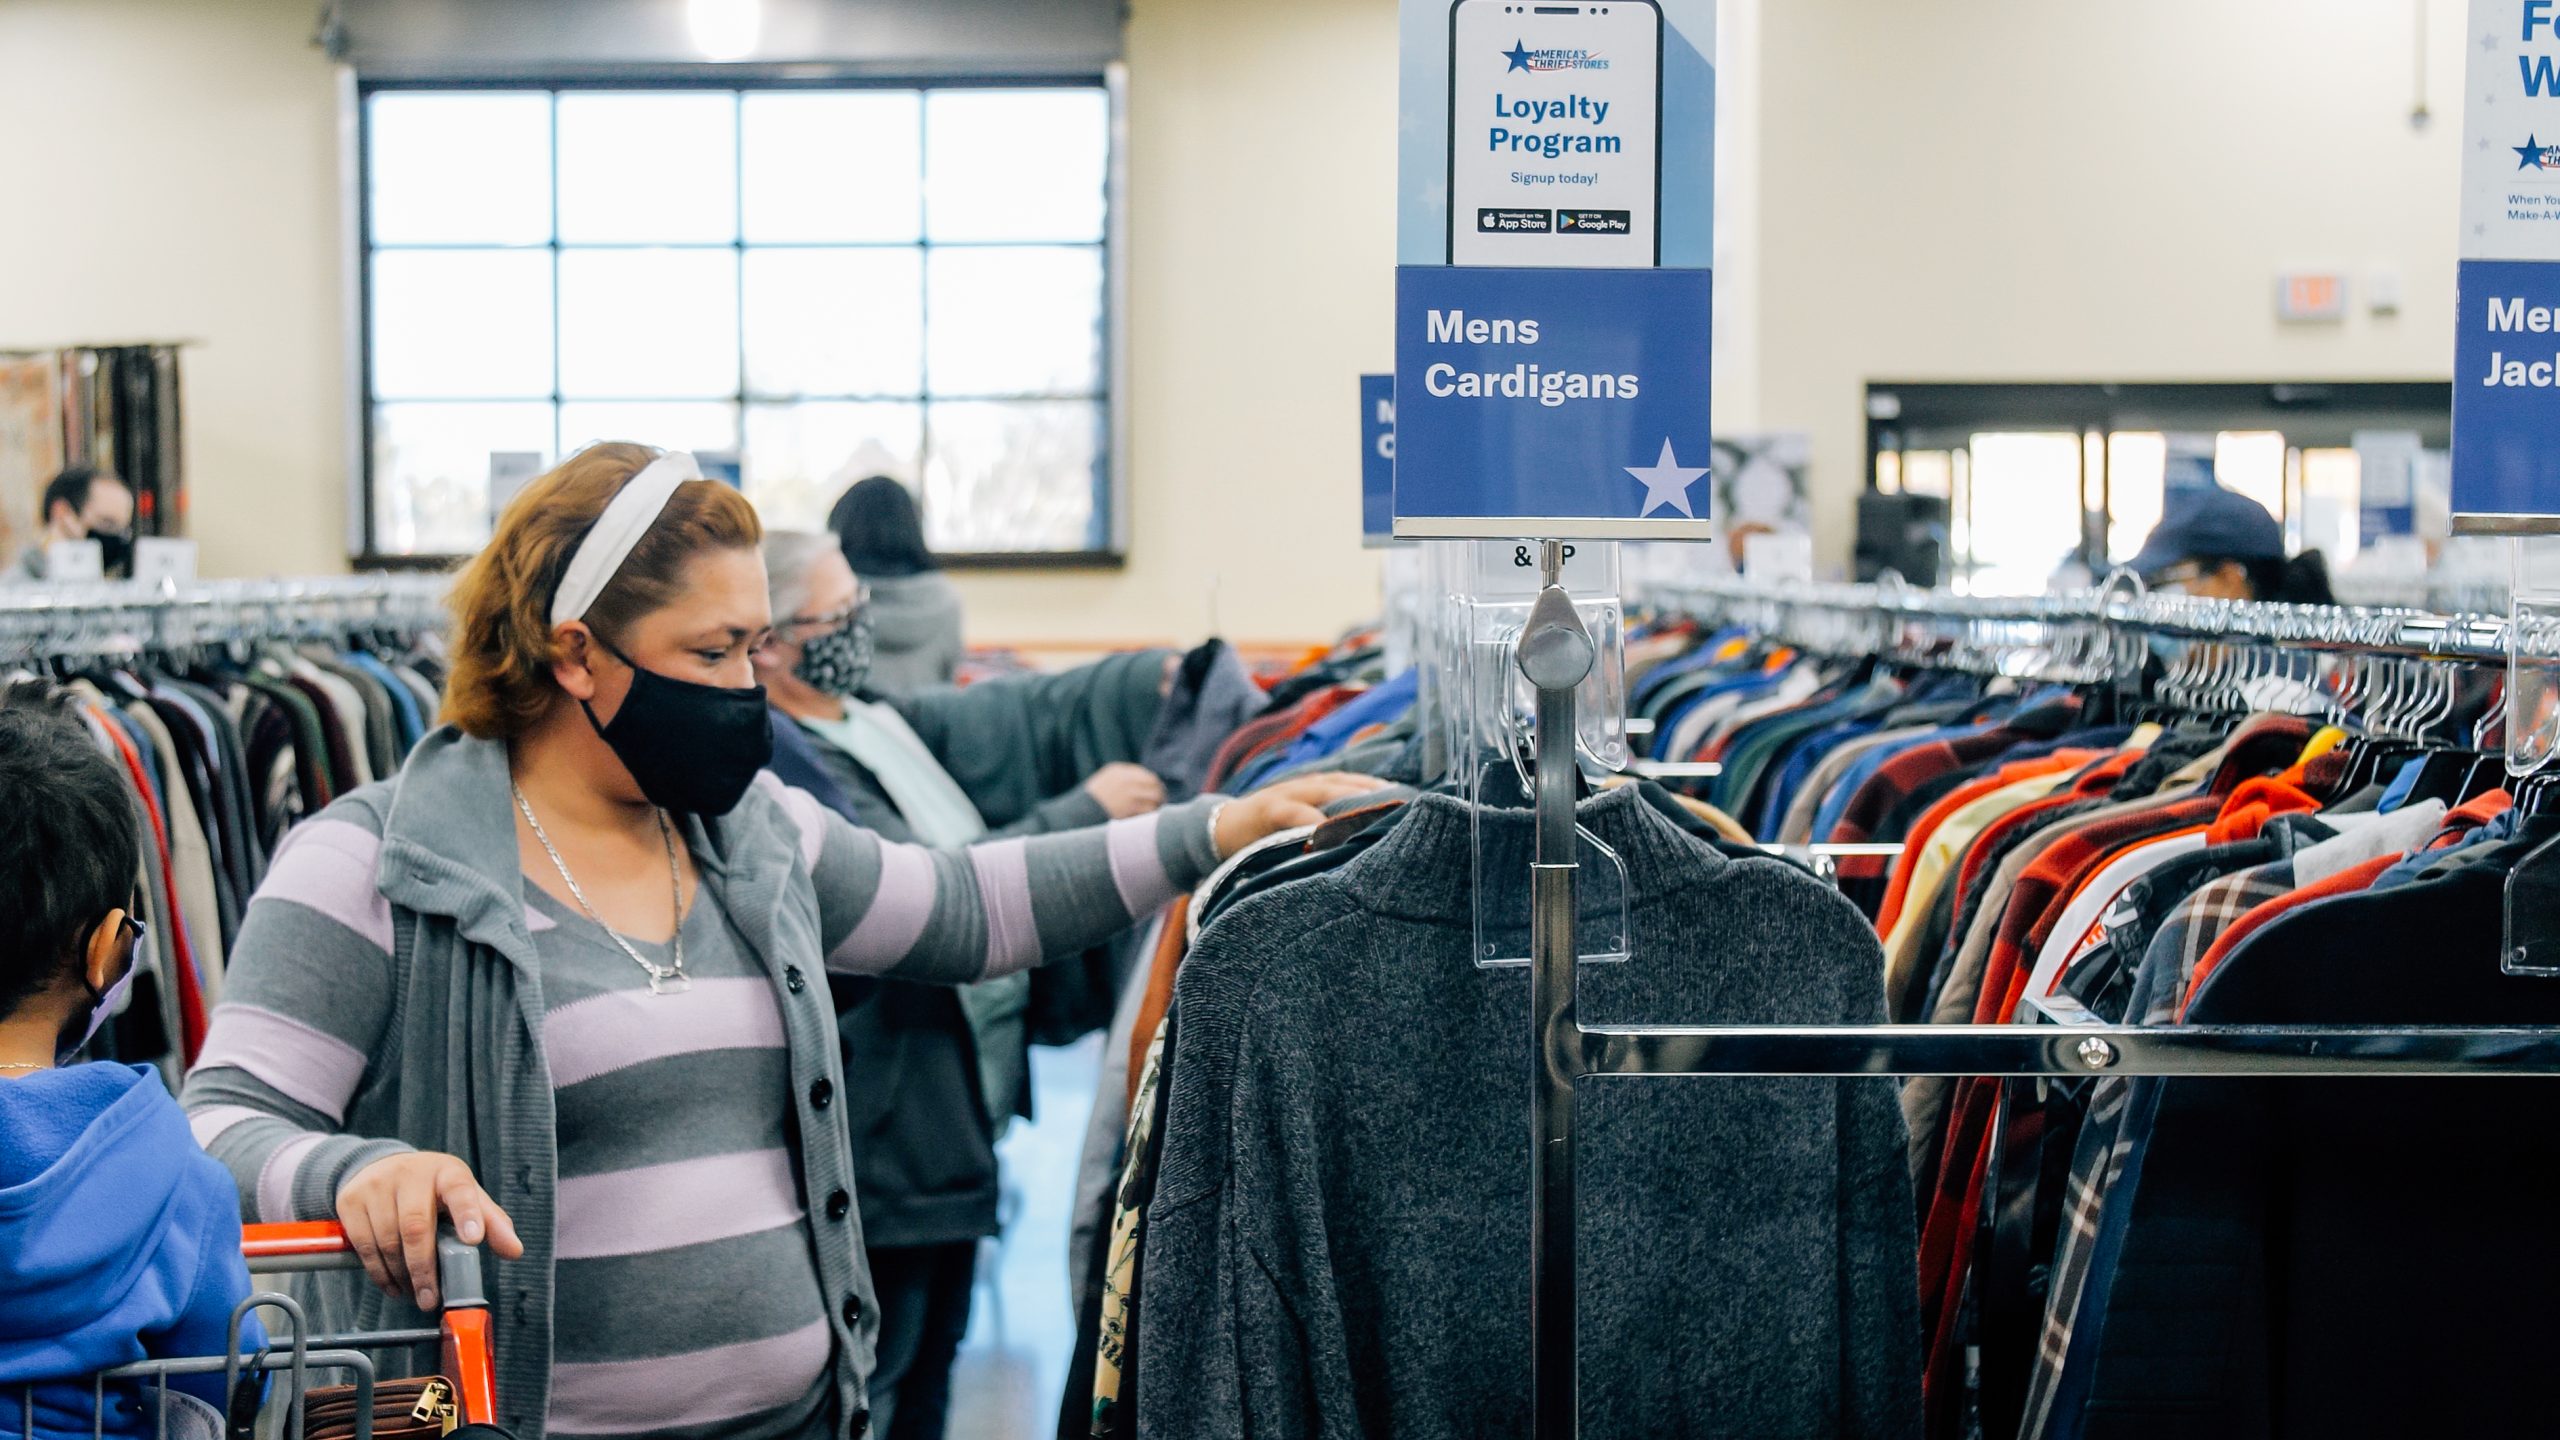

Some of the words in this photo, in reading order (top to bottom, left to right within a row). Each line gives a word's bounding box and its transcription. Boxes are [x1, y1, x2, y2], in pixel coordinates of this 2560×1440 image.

[1534, 49, 1587, 59] AMERICA'S
[1534, 59, 1571, 69] THRIFT
[1571, 60, 1609, 70] STORES
[1495, 93, 1610, 125] Loyalty
[1489, 127, 1621, 159] Program
[1511, 172, 1555, 186] Signup
[1559, 173, 1599, 187] today!
[2508, 194, 2541, 205] When
[1498, 218, 1520, 230] App
[1520, 218, 1547, 229] Store
[1578, 219, 1608, 231] Google
[1608, 219, 1627, 231] Play
[1427, 309, 1540, 345] Mens
[1424, 362, 1640, 407] Cardigans
[1513, 545, 1533, 568] &
